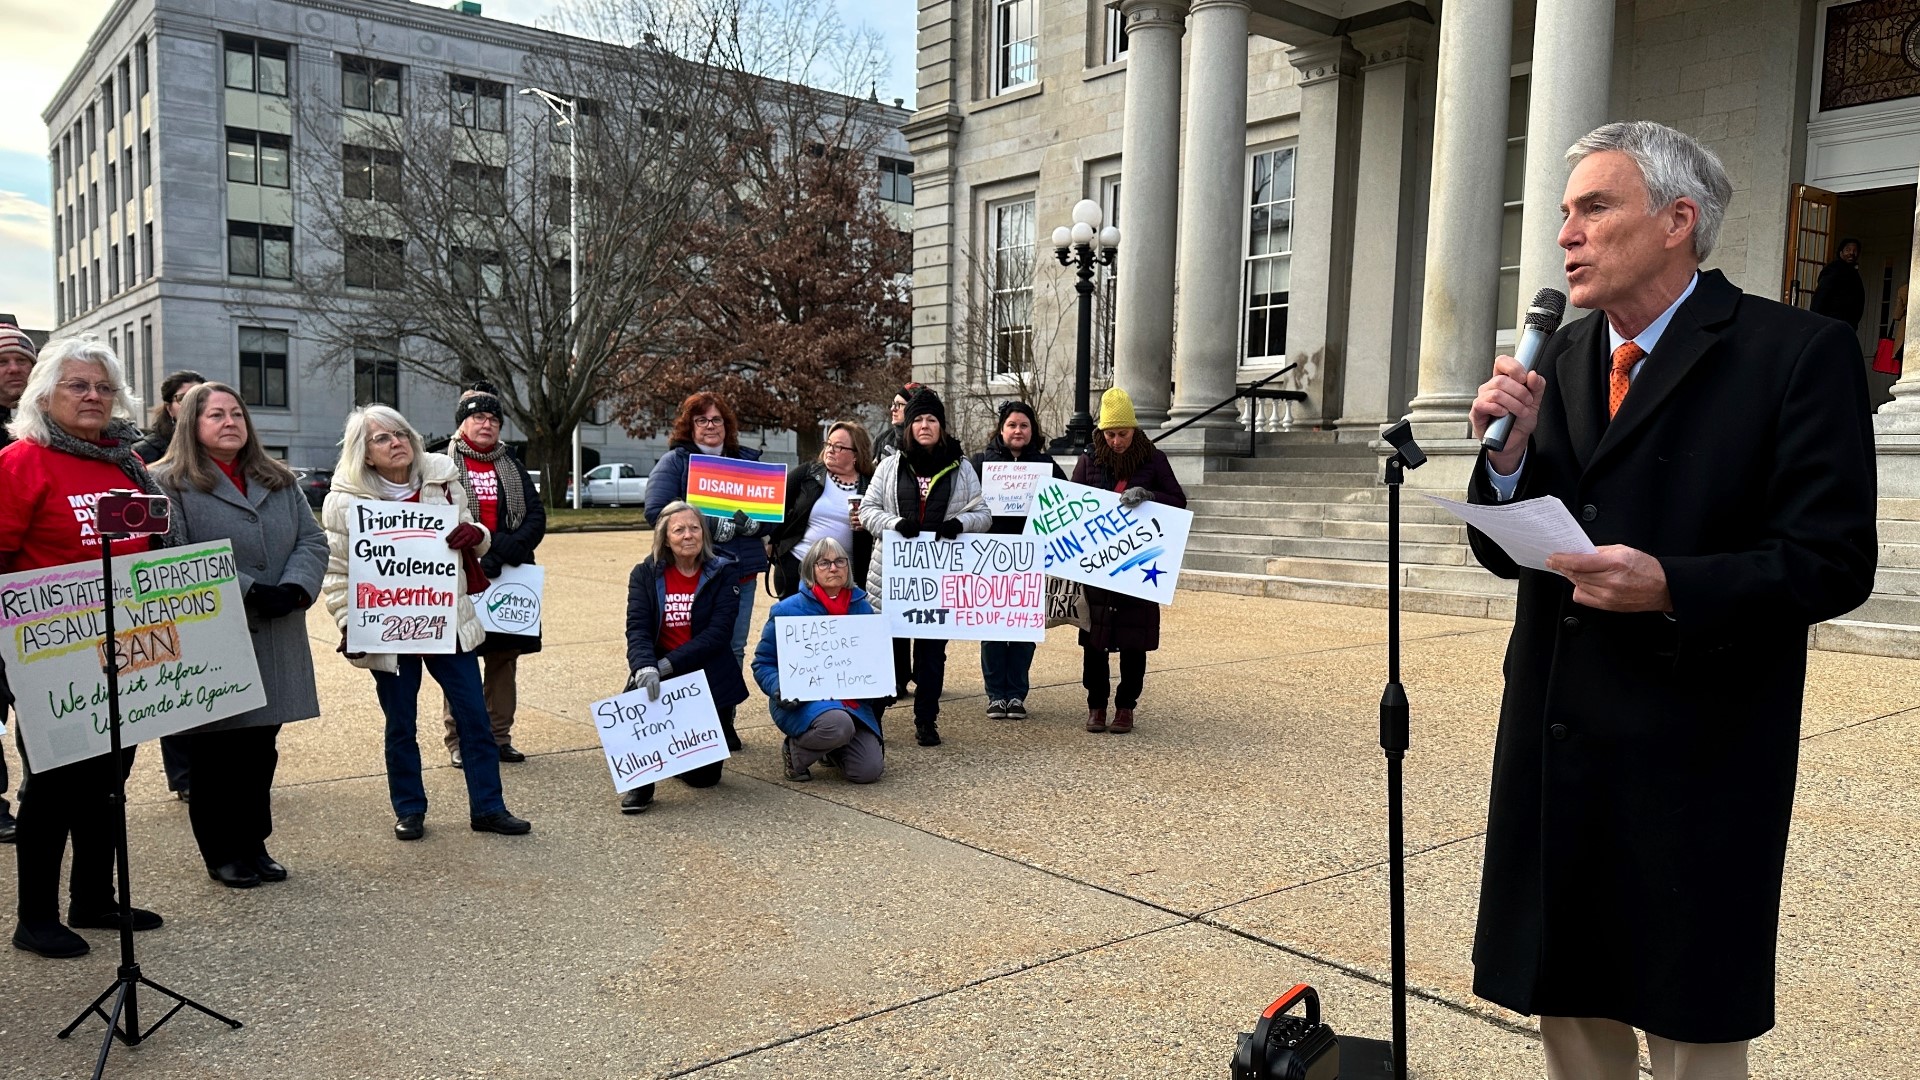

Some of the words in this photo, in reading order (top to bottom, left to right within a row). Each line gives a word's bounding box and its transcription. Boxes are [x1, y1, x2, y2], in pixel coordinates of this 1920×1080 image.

[699, 477, 744, 496] DISARM
[746, 484, 775, 499] HATE
[356, 504, 445, 533] Prioritize
[1032, 491, 1100, 535] NEEDS
[355, 539, 395, 562] Gun
[892, 541, 965, 572] HAVE
[971, 539, 1035, 575] YOU
[375, 559, 456, 577] Violence
[1, 578, 104, 619] REINSTATE
[113, 579, 133, 600] the
[135, 553, 236, 595] BIPARTISAN
[356, 582, 454, 610] Prevention
[889, 576, 938, 602] HAD
[941, 573, 1042, 609] ENOUGH
[125, 590, 216, 627] WEAPONS
[493, 592, 536, 609] COMMON
[357, 611, 385, 628] for
[381, 616, 447, 642] 2024
[902, 608, 950, 625] TEXT
[785, 619, 838, 644] PLEASE
[804, 636, 860, 658] SECURE
[836, 671, 878, 689] Home
[49, 681, 87, 719] We
[126, 675, 148, 695] it
[176, 690, 194, 709] it
[597, 700, 647, 729] Stop
[661, 682, 701, 715] guns
[631, 719, 675, 741] from
[668, 728, 718, 756] children
